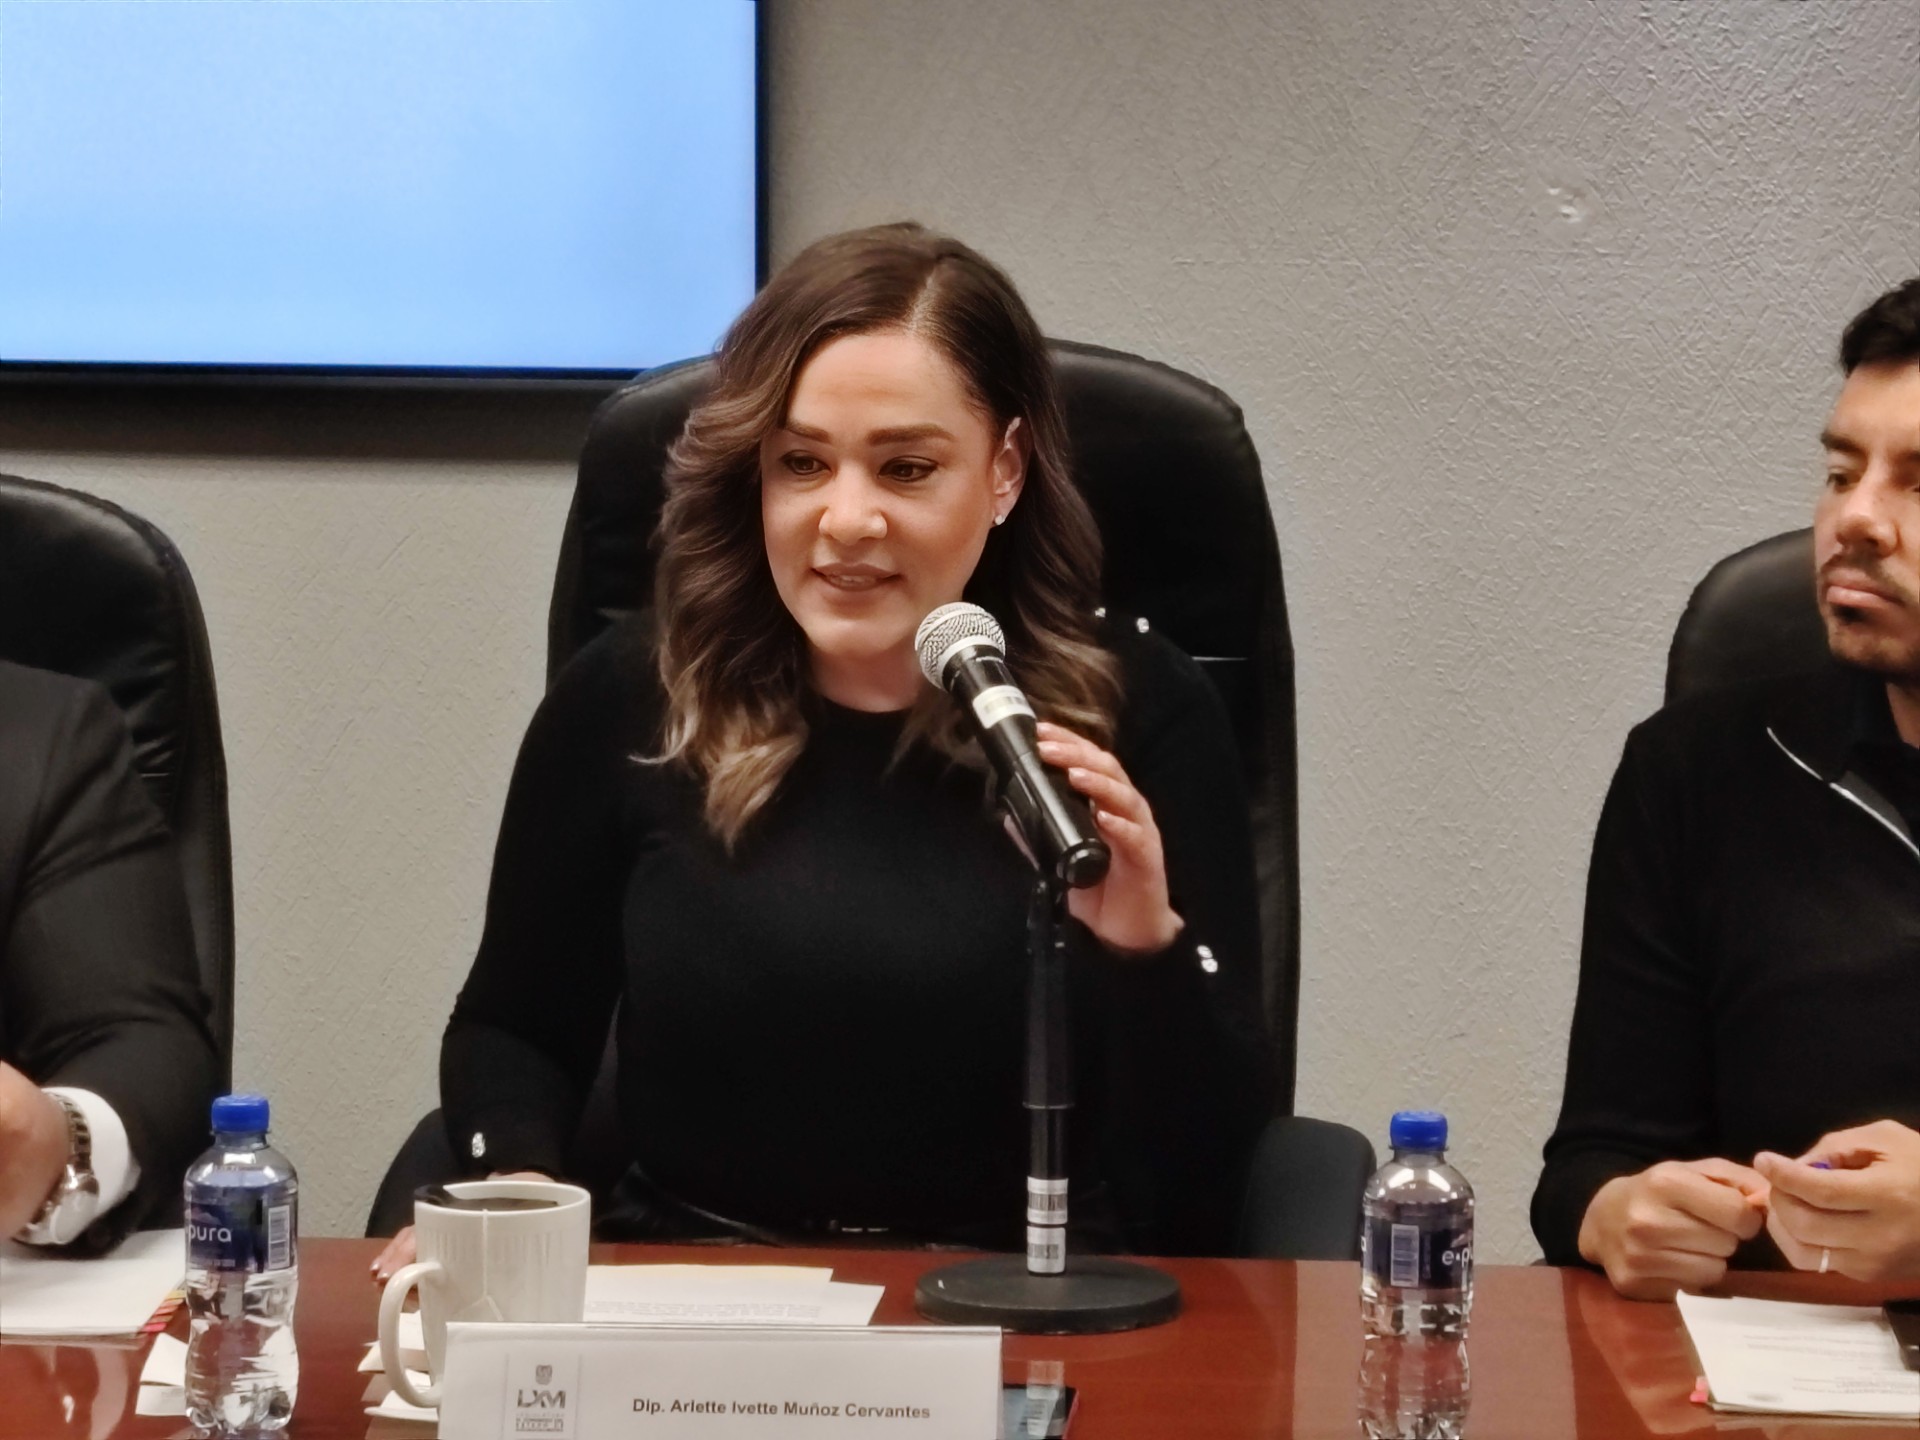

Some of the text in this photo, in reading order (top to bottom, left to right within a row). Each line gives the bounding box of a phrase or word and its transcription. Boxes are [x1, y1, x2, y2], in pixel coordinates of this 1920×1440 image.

[633, 1398, 930, 1419] Dip. Arlette Ivette Muñoz Cervantes
